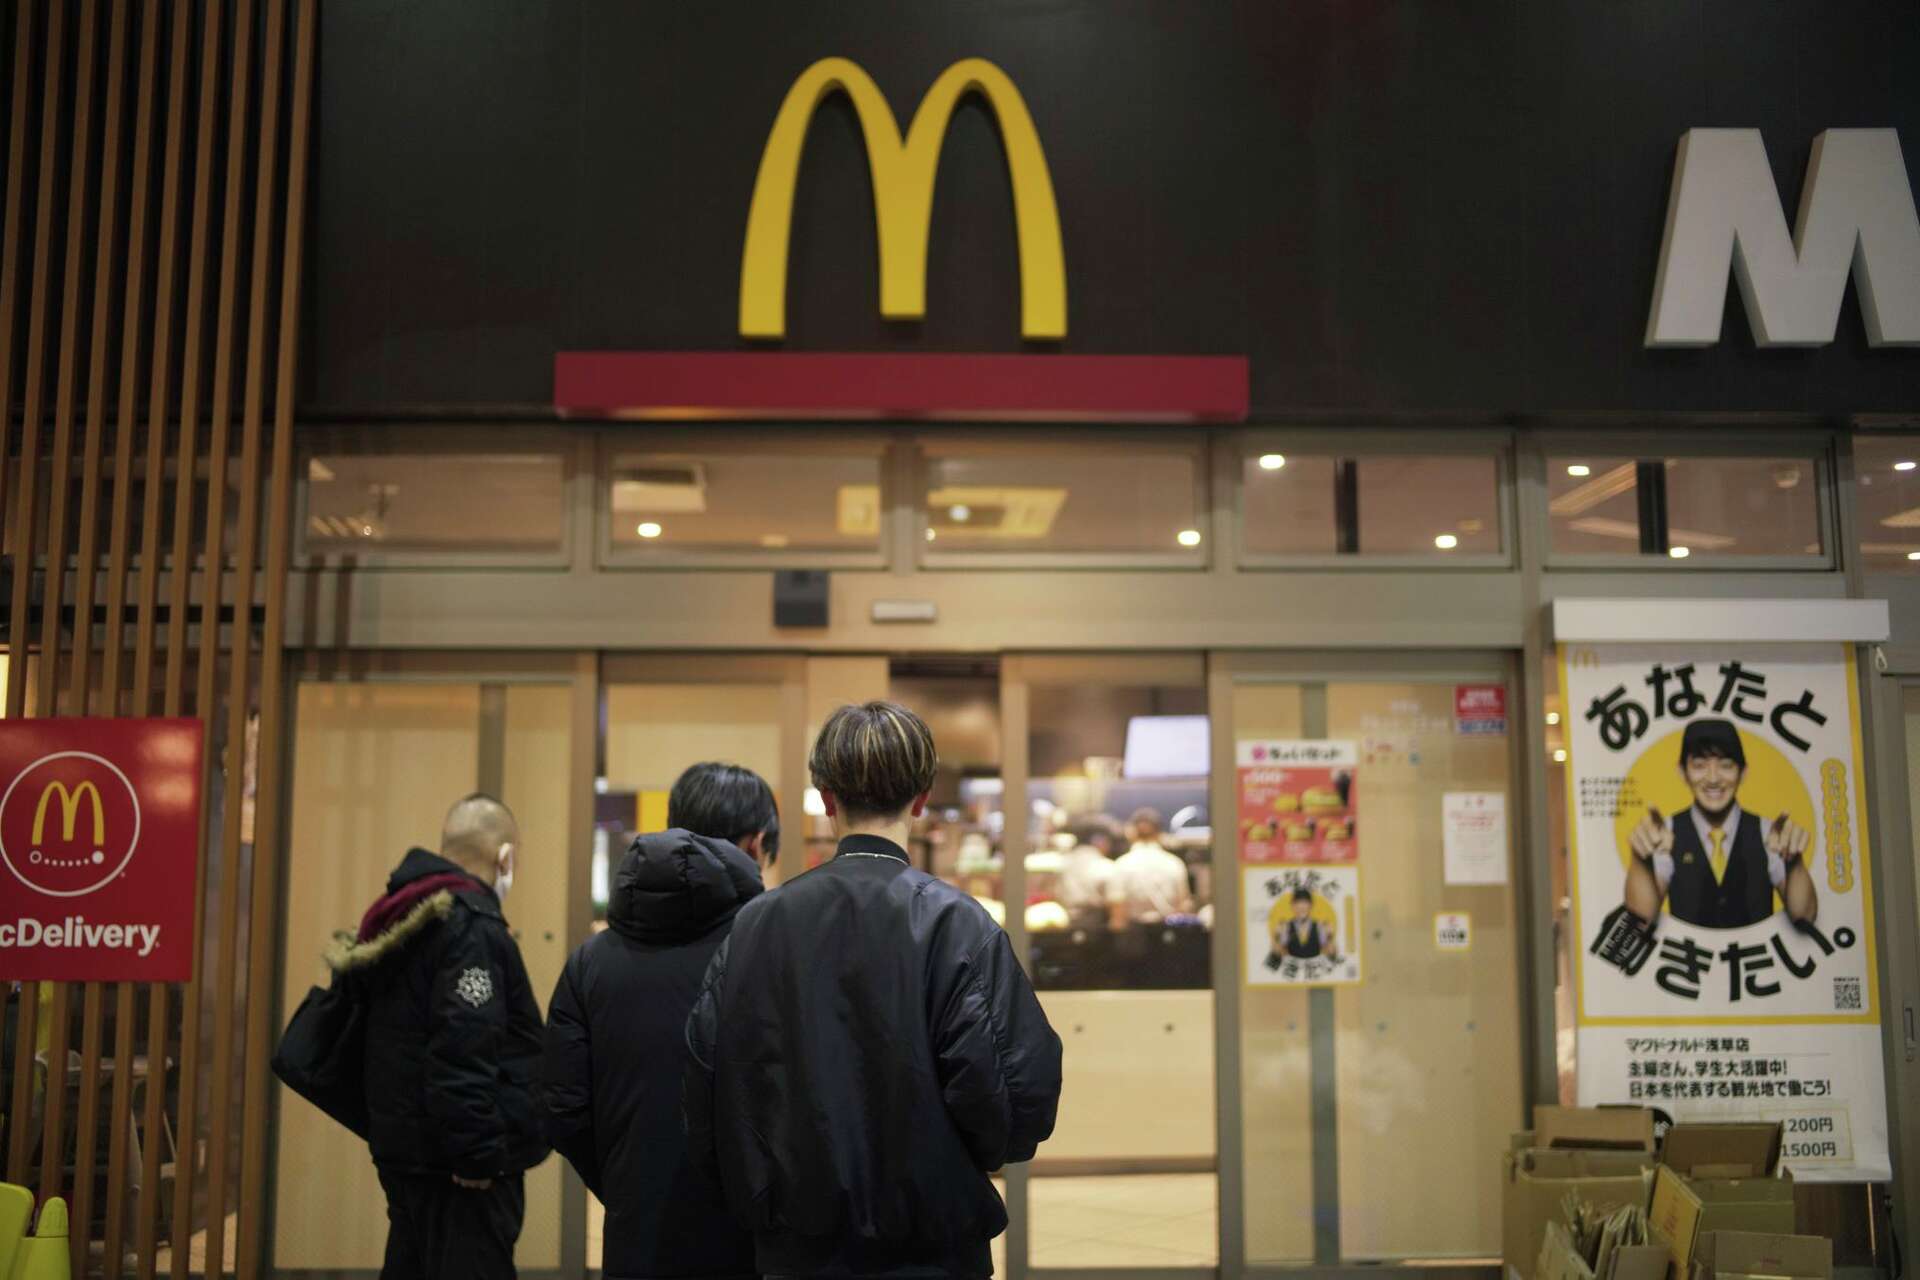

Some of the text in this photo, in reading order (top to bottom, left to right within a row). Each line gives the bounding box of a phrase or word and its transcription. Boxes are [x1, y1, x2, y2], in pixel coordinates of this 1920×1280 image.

[1644, 127, 1920, 348] M
[1585, 660, 1827, 753] あなたと
[1626, 1037, 1750, 1053] マクドナルド浅草店
[1784, 1116, 1833, 1132] 200円
